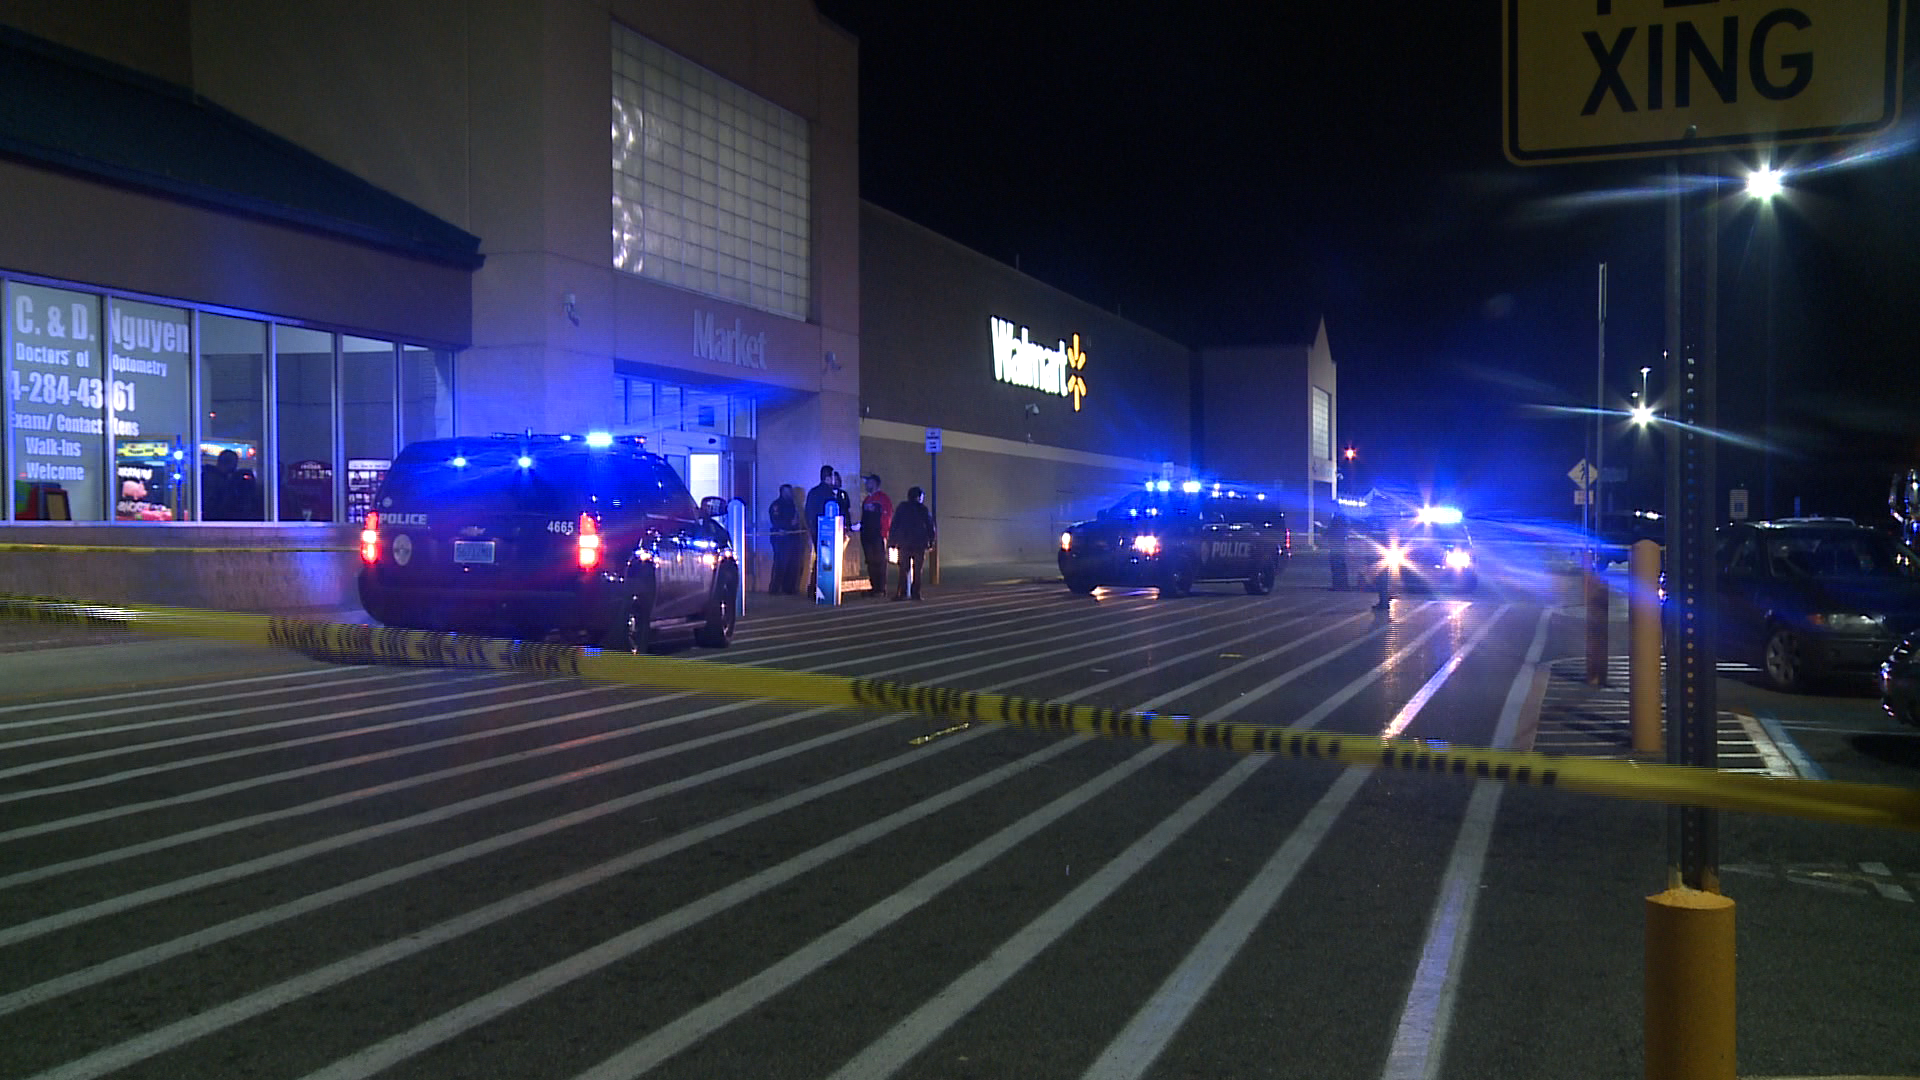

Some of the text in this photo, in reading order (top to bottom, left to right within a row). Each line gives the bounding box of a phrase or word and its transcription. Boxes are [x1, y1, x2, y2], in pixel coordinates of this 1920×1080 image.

[1581, 8, 1814, 116] XING
[16, 295, 189, 353] C. & D. Nguyen
[693, 309, 767, 371] Market
[16, 342, 168, 377] Doctors of Optometry
[991, 316, 1068, 397] Walmart
[57, 414, 104, 434] Contact
[25, 437, 82, 457] Walk-Ins
[26, 462, 85, 481] Welcome
[379, 513, 428, 525] POLICE
[547, 521, 574, 534] 4665
[1211, 541, 1250, 558] POLICE
